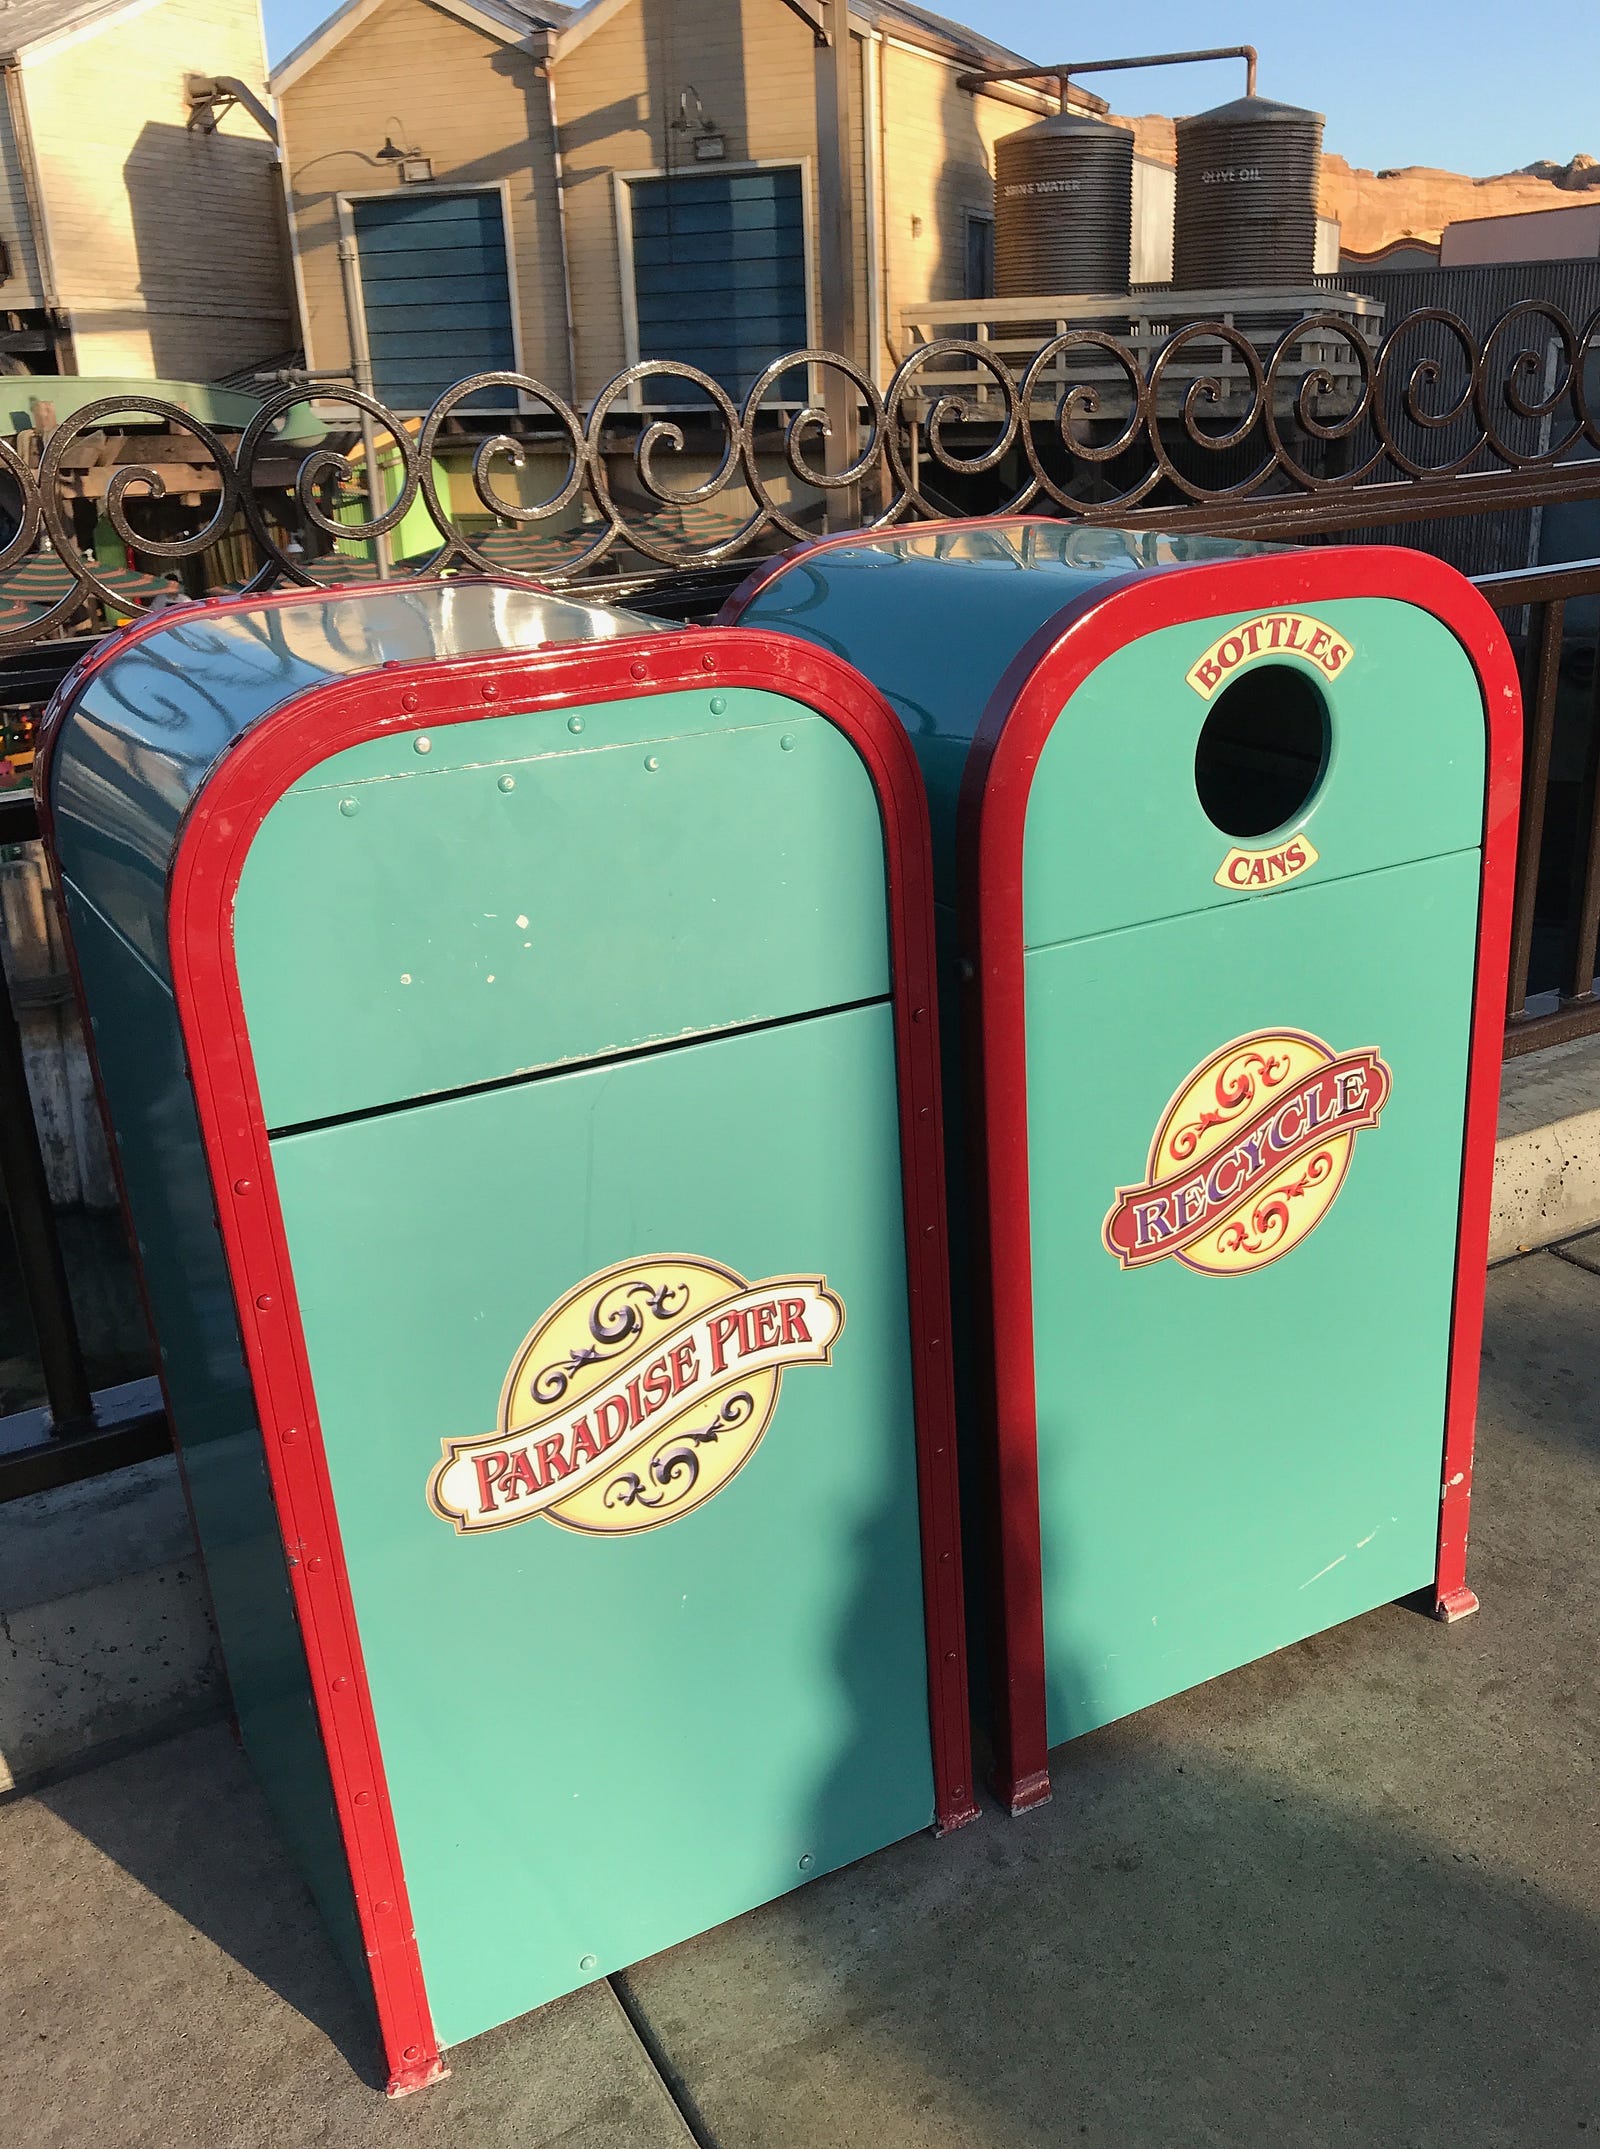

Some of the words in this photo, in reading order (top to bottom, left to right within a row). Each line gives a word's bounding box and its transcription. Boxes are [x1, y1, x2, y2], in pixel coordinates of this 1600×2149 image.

[1036, 180, 1081, 193] WATER
[1239, 168, 1261, 181] OIL
[1194, 617, 1347, 691] BOTTLES
[1228, 843, 1306, 885] CANS
[1132, 1067, 1370, 1249] RECYCLE
[471, 1335, 700, 1514] PARADISE
[706, 1297, 813, 1377] PIER
